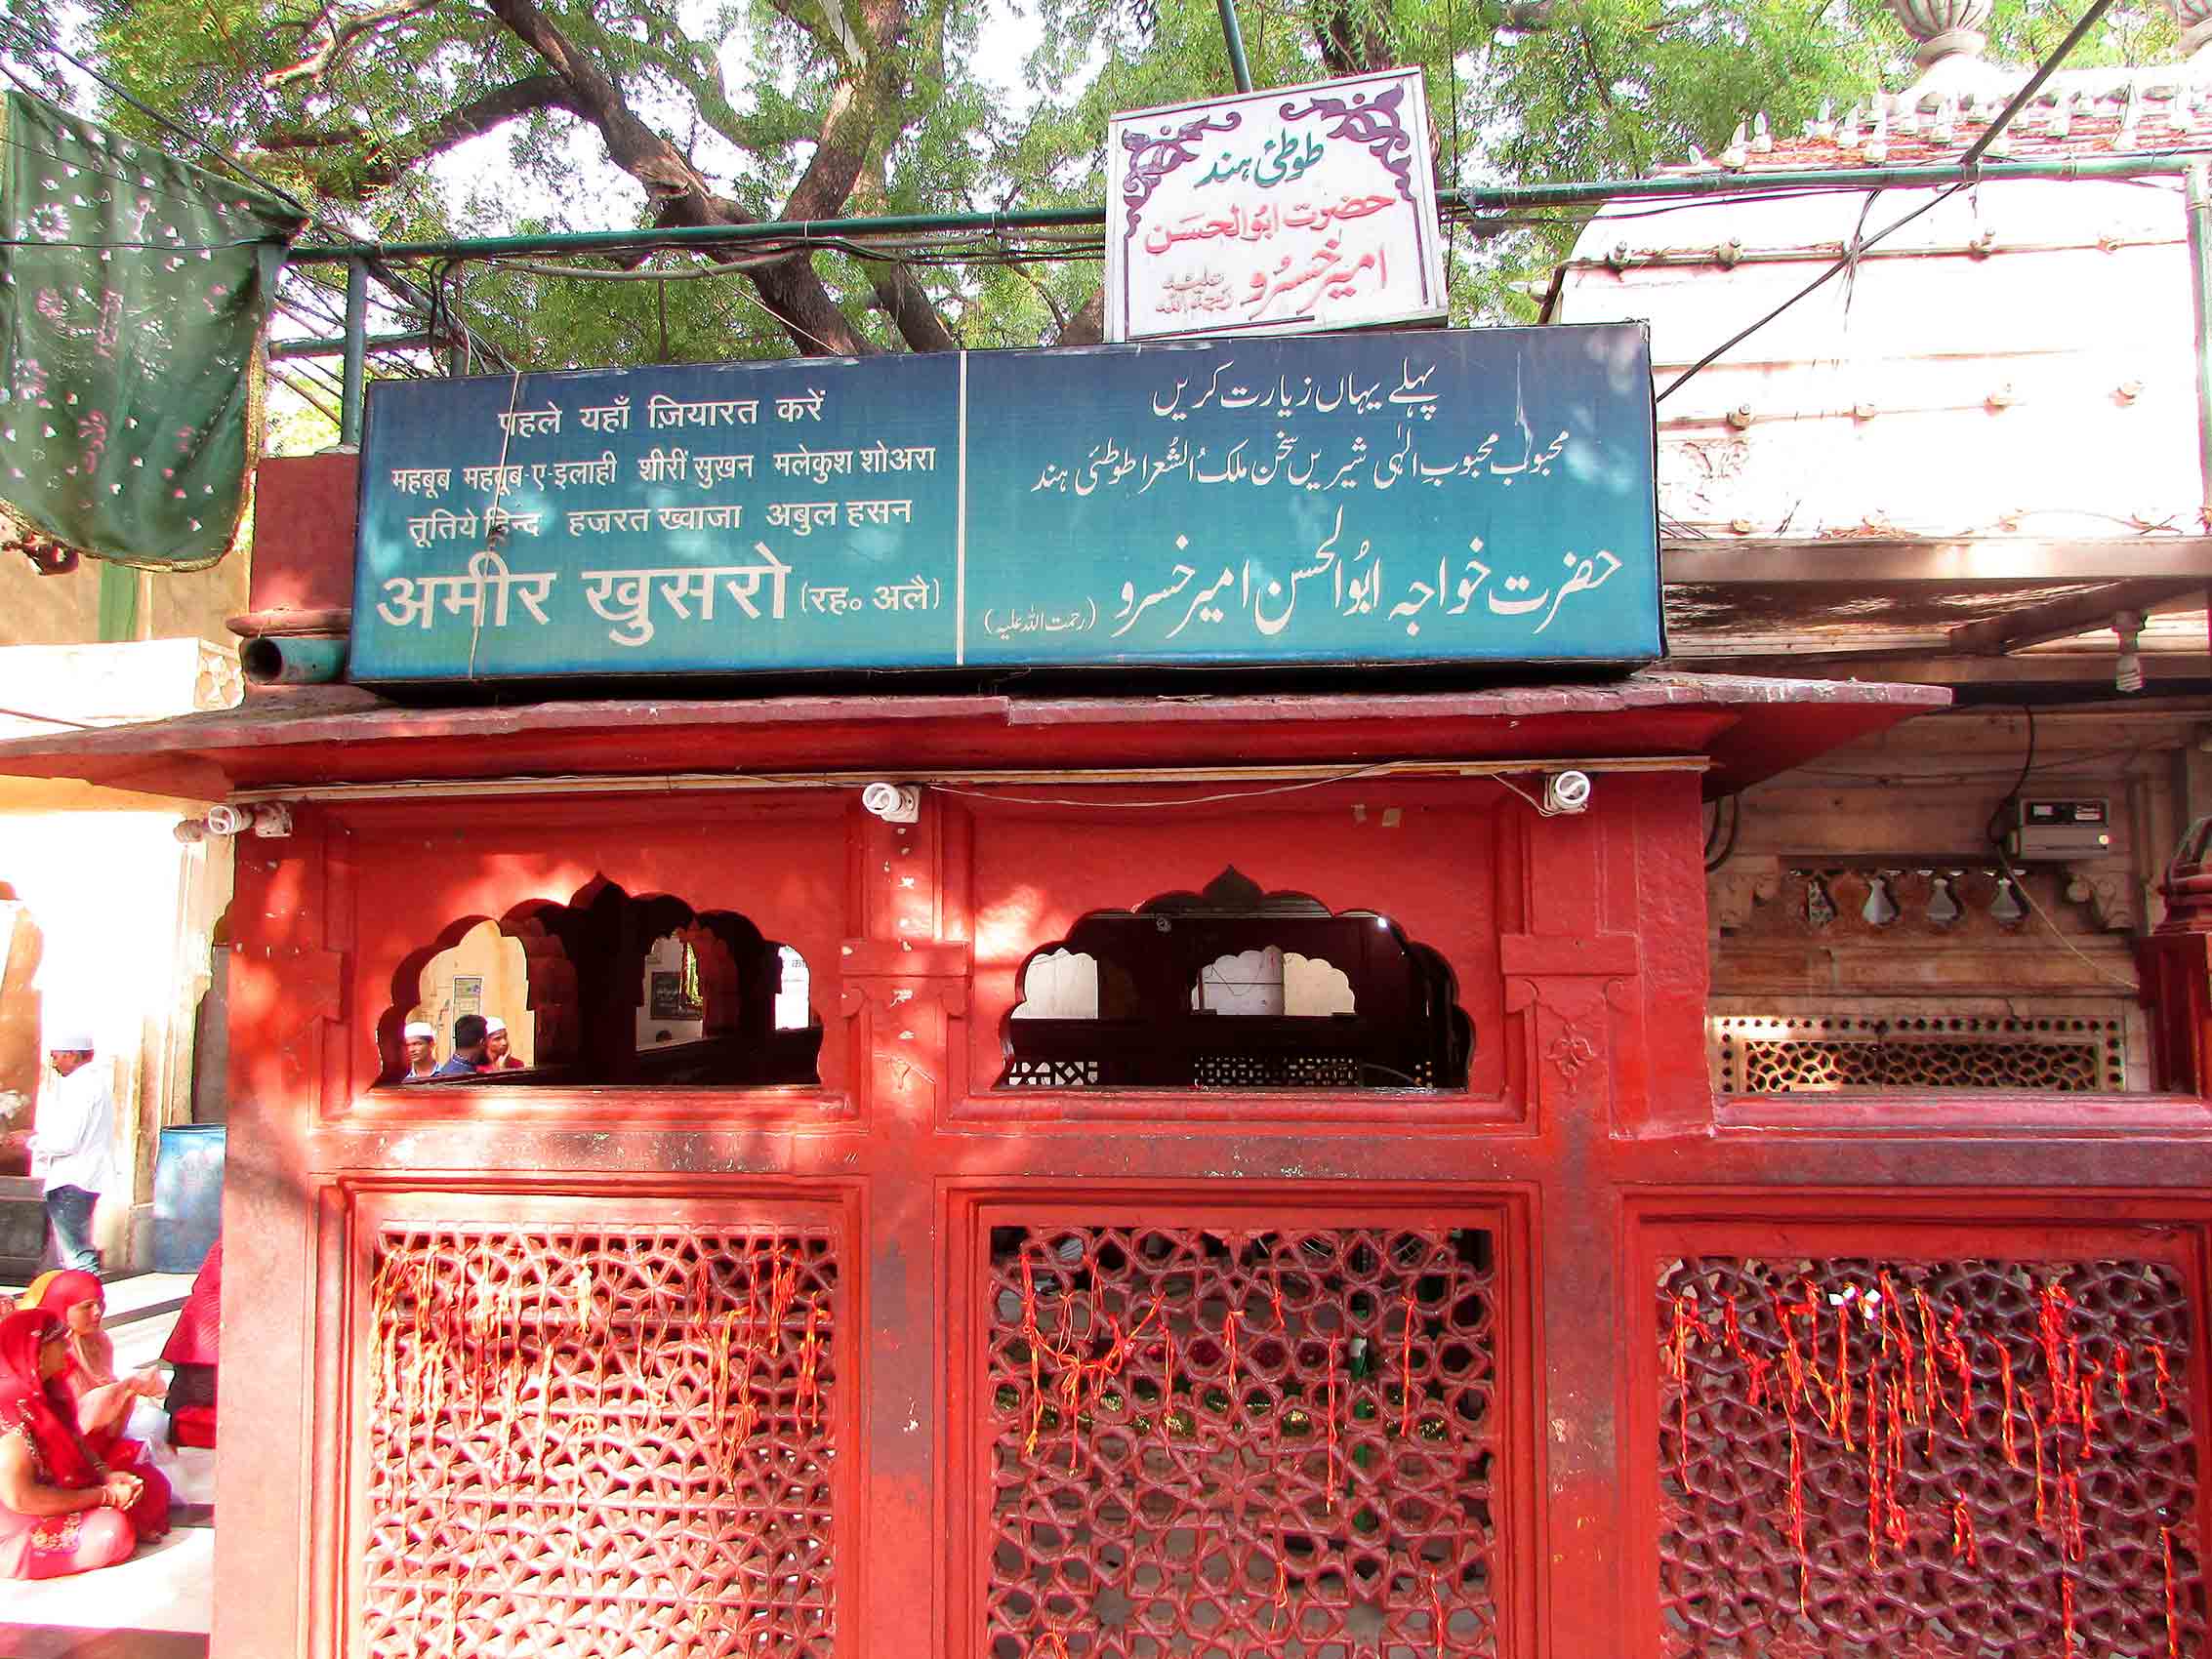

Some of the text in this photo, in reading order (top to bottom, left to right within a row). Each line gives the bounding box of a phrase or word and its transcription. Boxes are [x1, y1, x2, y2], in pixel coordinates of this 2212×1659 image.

[1283, 194, 1396, 230] حضرت
[498, 387, 826, 437] पहले यहाँ ज़ियारत करें
[1153, 356, 1439, 421] پہلے یہاں زیارت کریں
[391, 467, 452, 499] महबूब
[637, 447, 689, 482] शीरीं
[773, 443, 854, 484] मलेकुश
[859, 439, 936, 474] शोअरा
[1030, 464, 1069, 493] ہند
[1250, 430, 1299, 486] سخن
[1288, 436, 1367, 491] شیریں
[1491, 429, 1570, 485] محبوب
[407, 507, 479, 547] तूतिये
[658, 505, 742, 531] ख्वाजा
[765, 502, 838, 536] अबुल
[846, 499, 913, 528] हसन
[377, 550, 557, 628] अमीर
[582, 541, 793, 646] खुसरो
[1111, 534, 1196, 638] خسرو
[1167, 557, 1249, 639] امیر
[1388, 537, 1492, 635] خواجہ
[1488, 549, 1622, 634] حضرت
